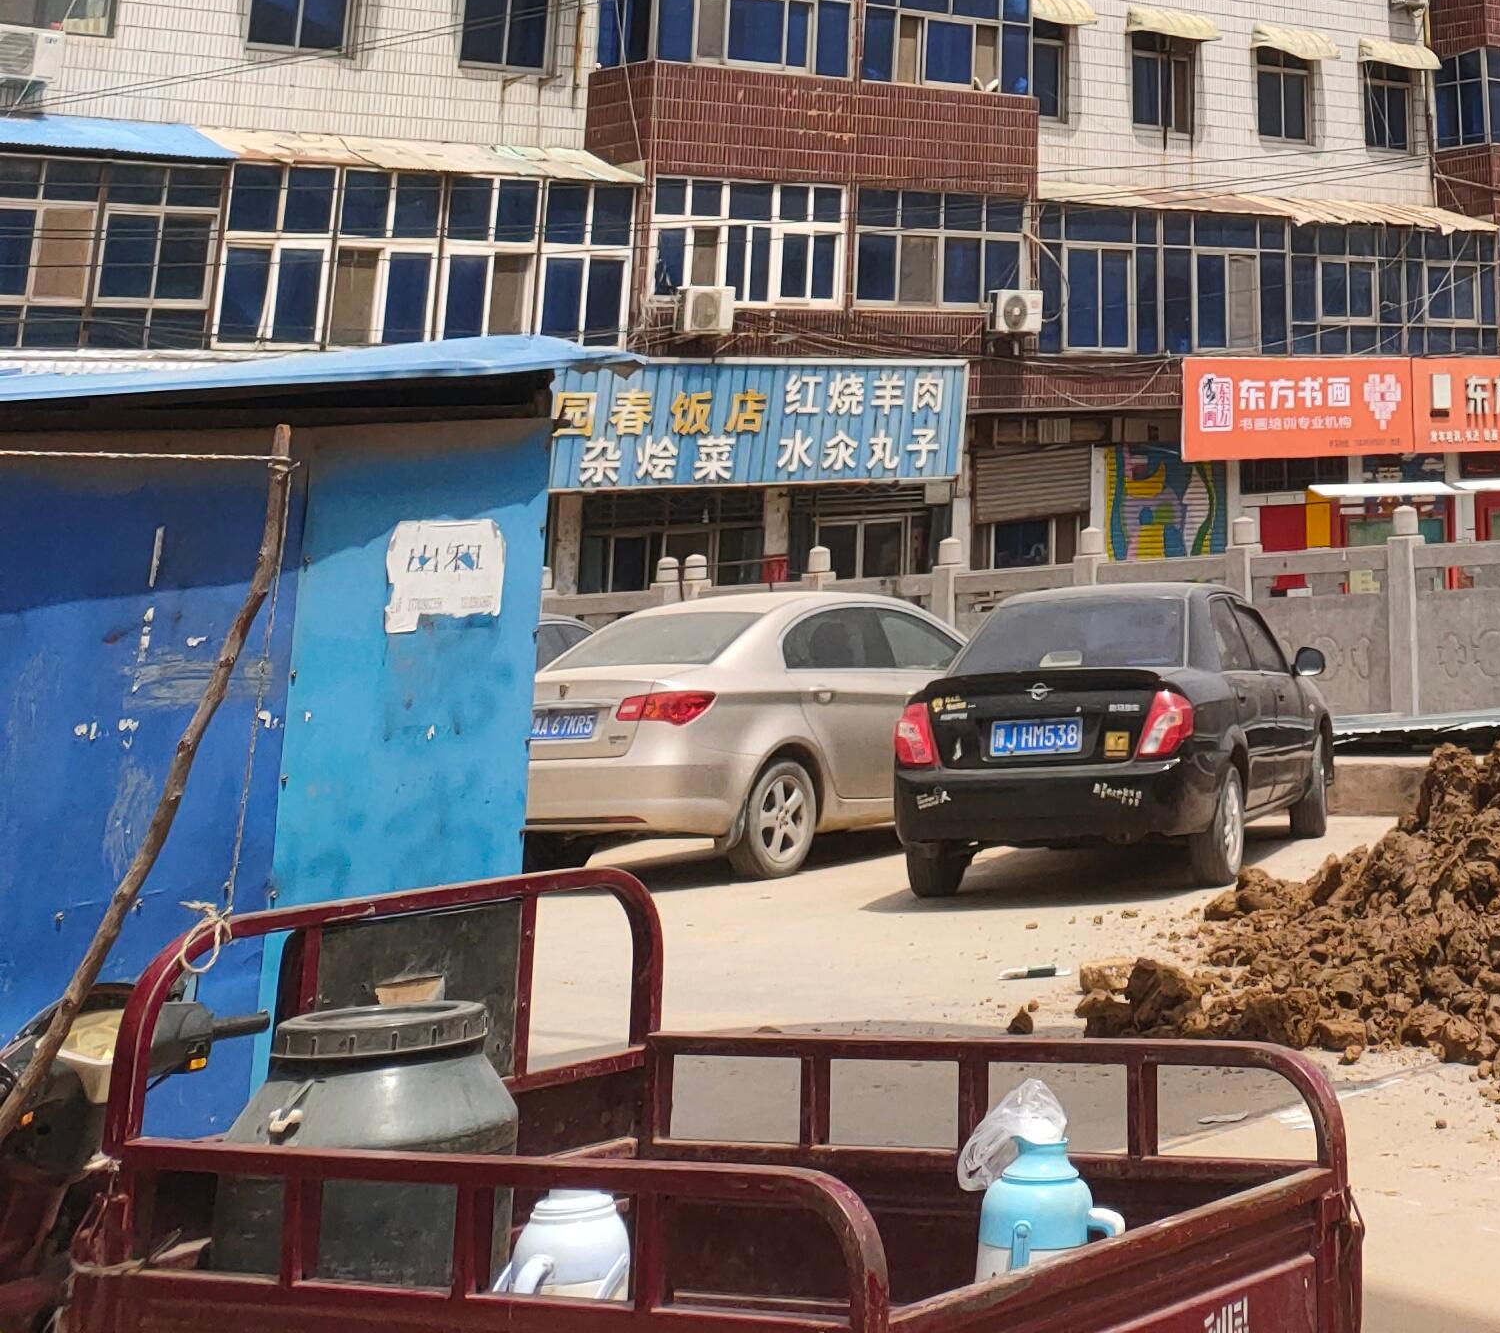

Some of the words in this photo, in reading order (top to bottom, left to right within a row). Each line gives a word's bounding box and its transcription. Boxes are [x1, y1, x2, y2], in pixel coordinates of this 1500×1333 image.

[552, 388, 768, 437] 园春饭店
[784, 372, 945, 416] 红烧羊肉
[1238, 376, 1351, 410] 东方书画
[1239, 416, 1352, 431] 书画培训专业机构
[579, 435, 737, 483] 杂烩菜
[777, 429, 940, 472] 水汆丸子
[406, 543, 483, 573] 出租
